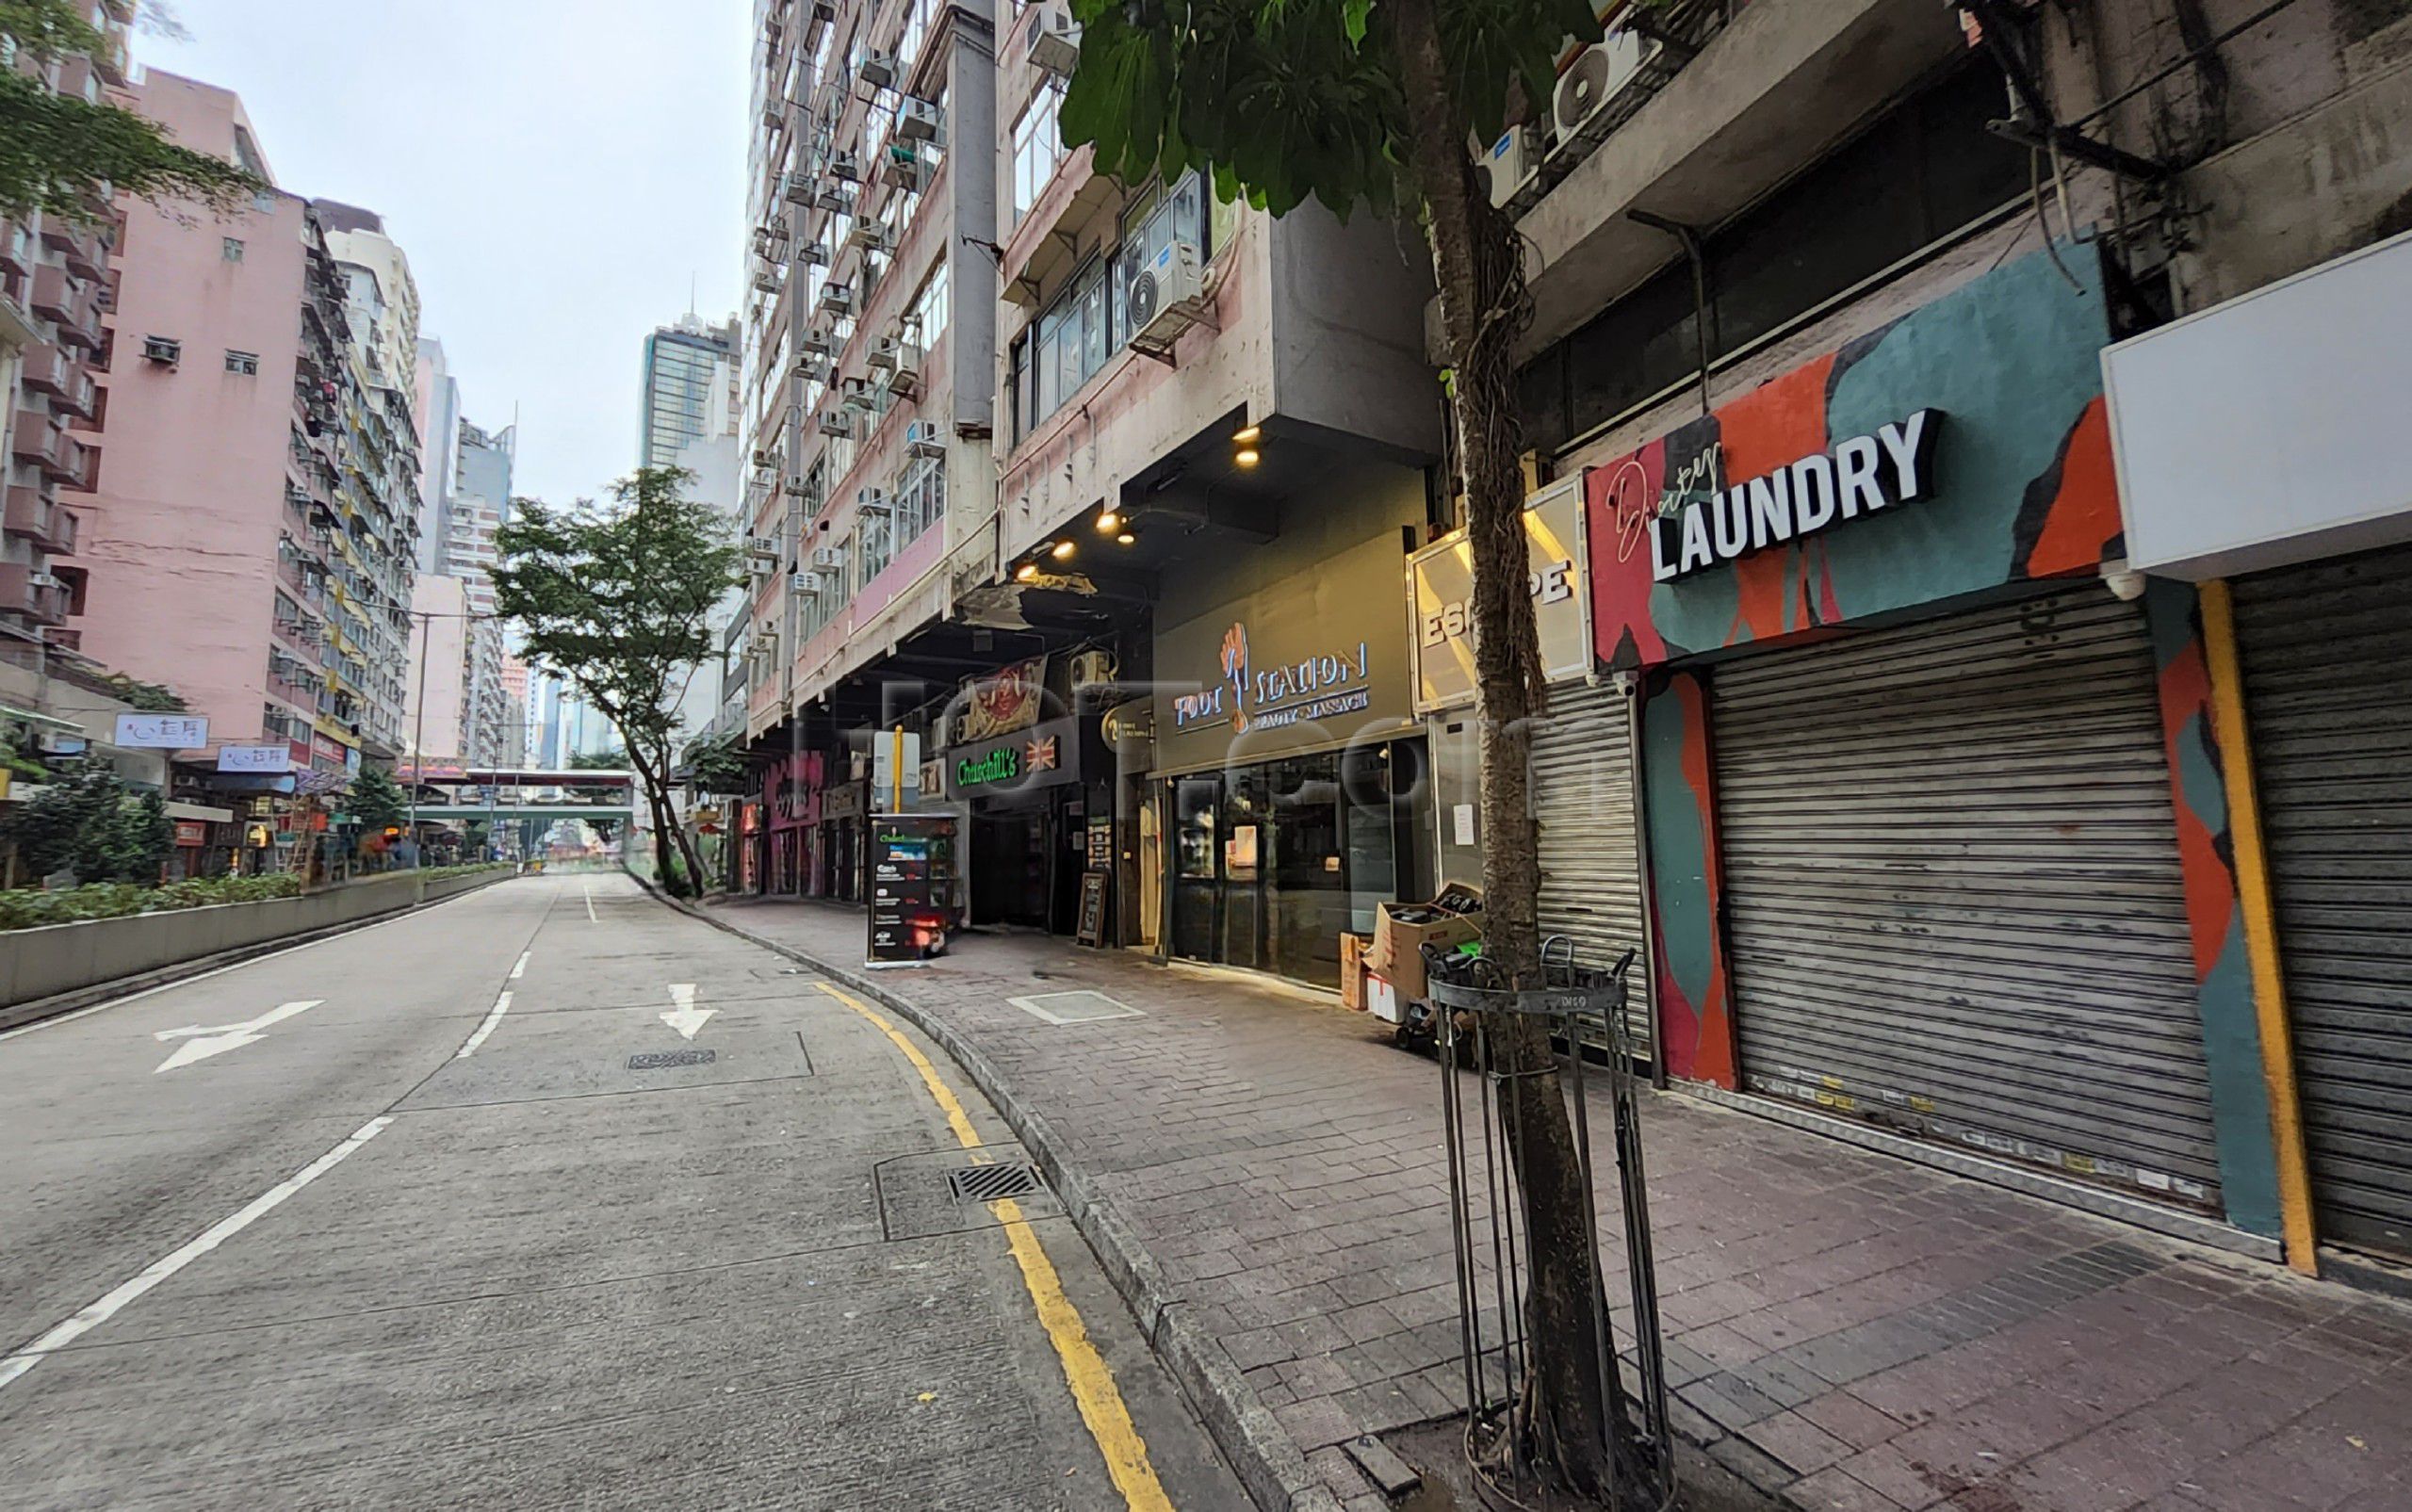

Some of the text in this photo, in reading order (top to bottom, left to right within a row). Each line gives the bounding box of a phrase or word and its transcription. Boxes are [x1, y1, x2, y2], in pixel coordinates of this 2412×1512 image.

[1650, 410, 1928, 582] LAUNDRY
[1174, 642, 1369, 726] FOOT STATION
[956, 746, 1017, 787] Churchill's
